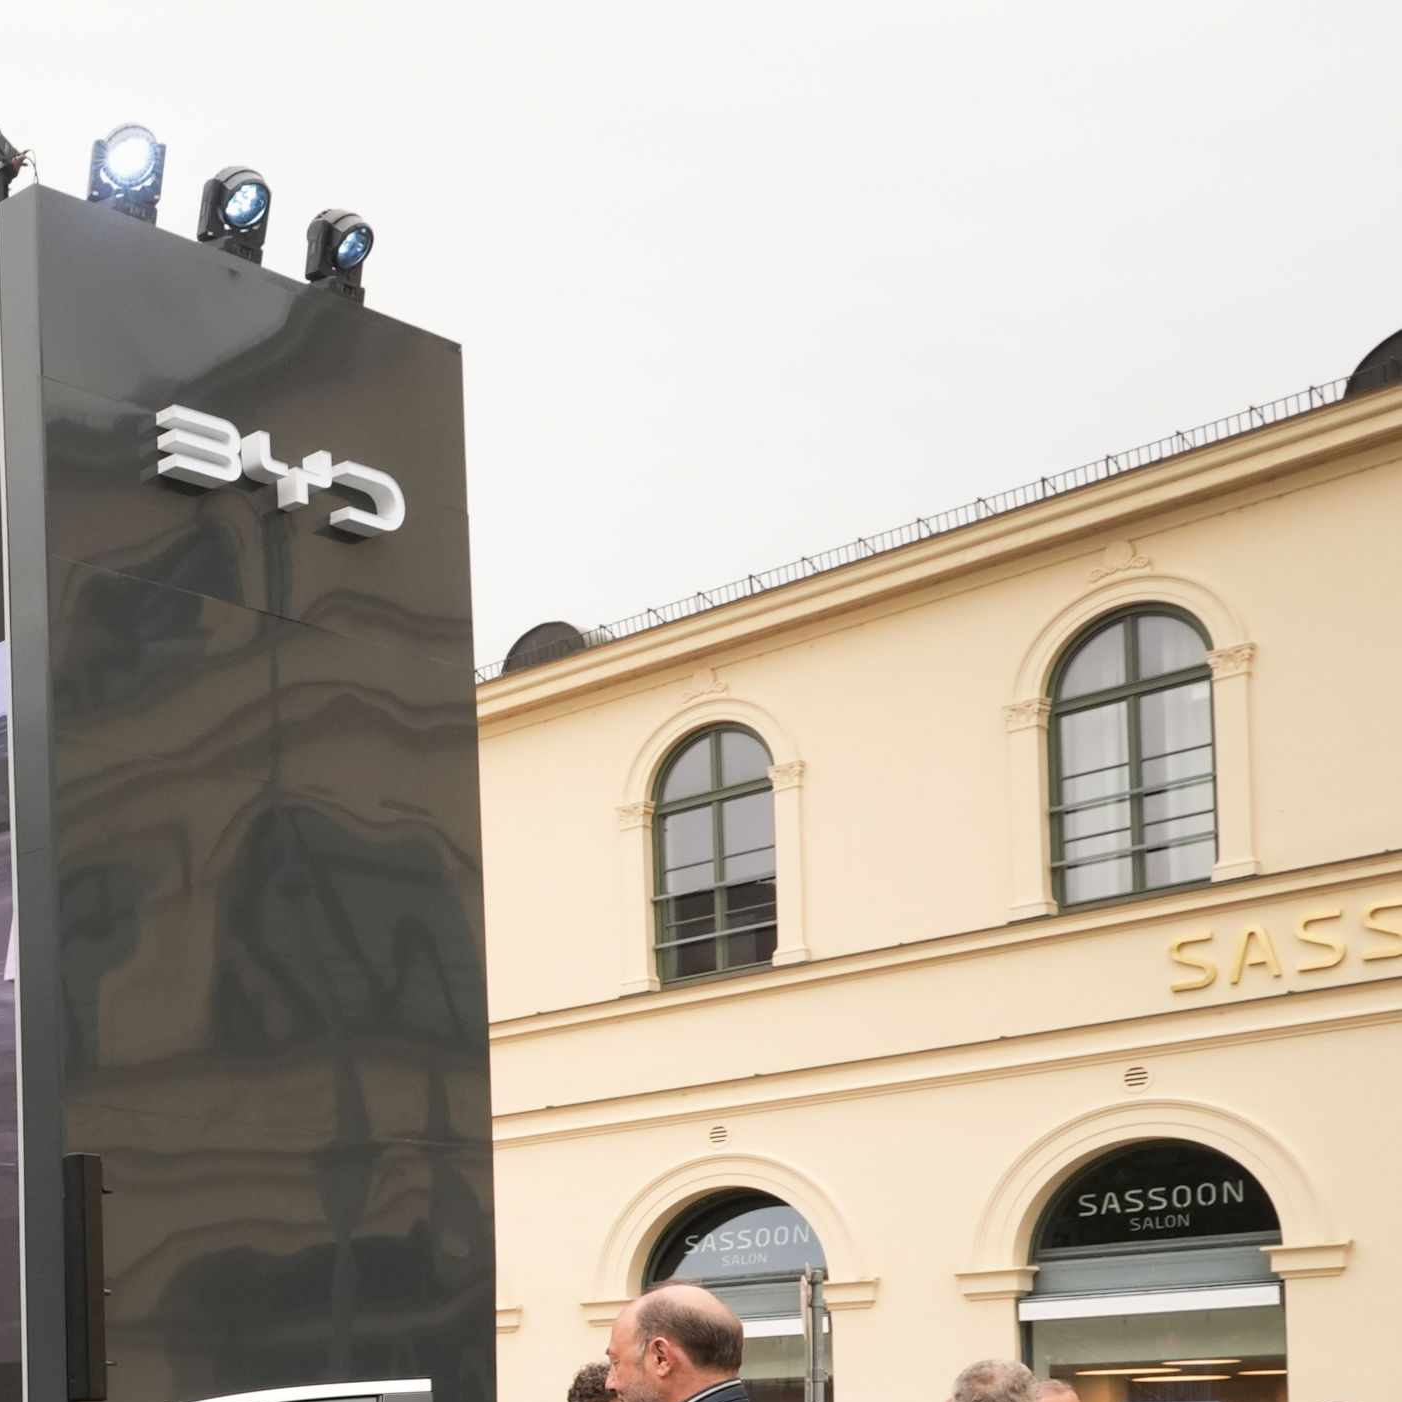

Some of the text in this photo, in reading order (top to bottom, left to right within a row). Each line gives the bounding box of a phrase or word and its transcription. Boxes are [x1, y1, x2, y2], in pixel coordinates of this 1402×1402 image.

[156, 404, 406, 538] BYD
[1078, 1179, 1245, 1217] SASSOON
[1129, 1214, 1191, 1232] SALON
[684, 1224, 810, 1255] SASSOON
[722, 1252, 768, 1267] SALON
